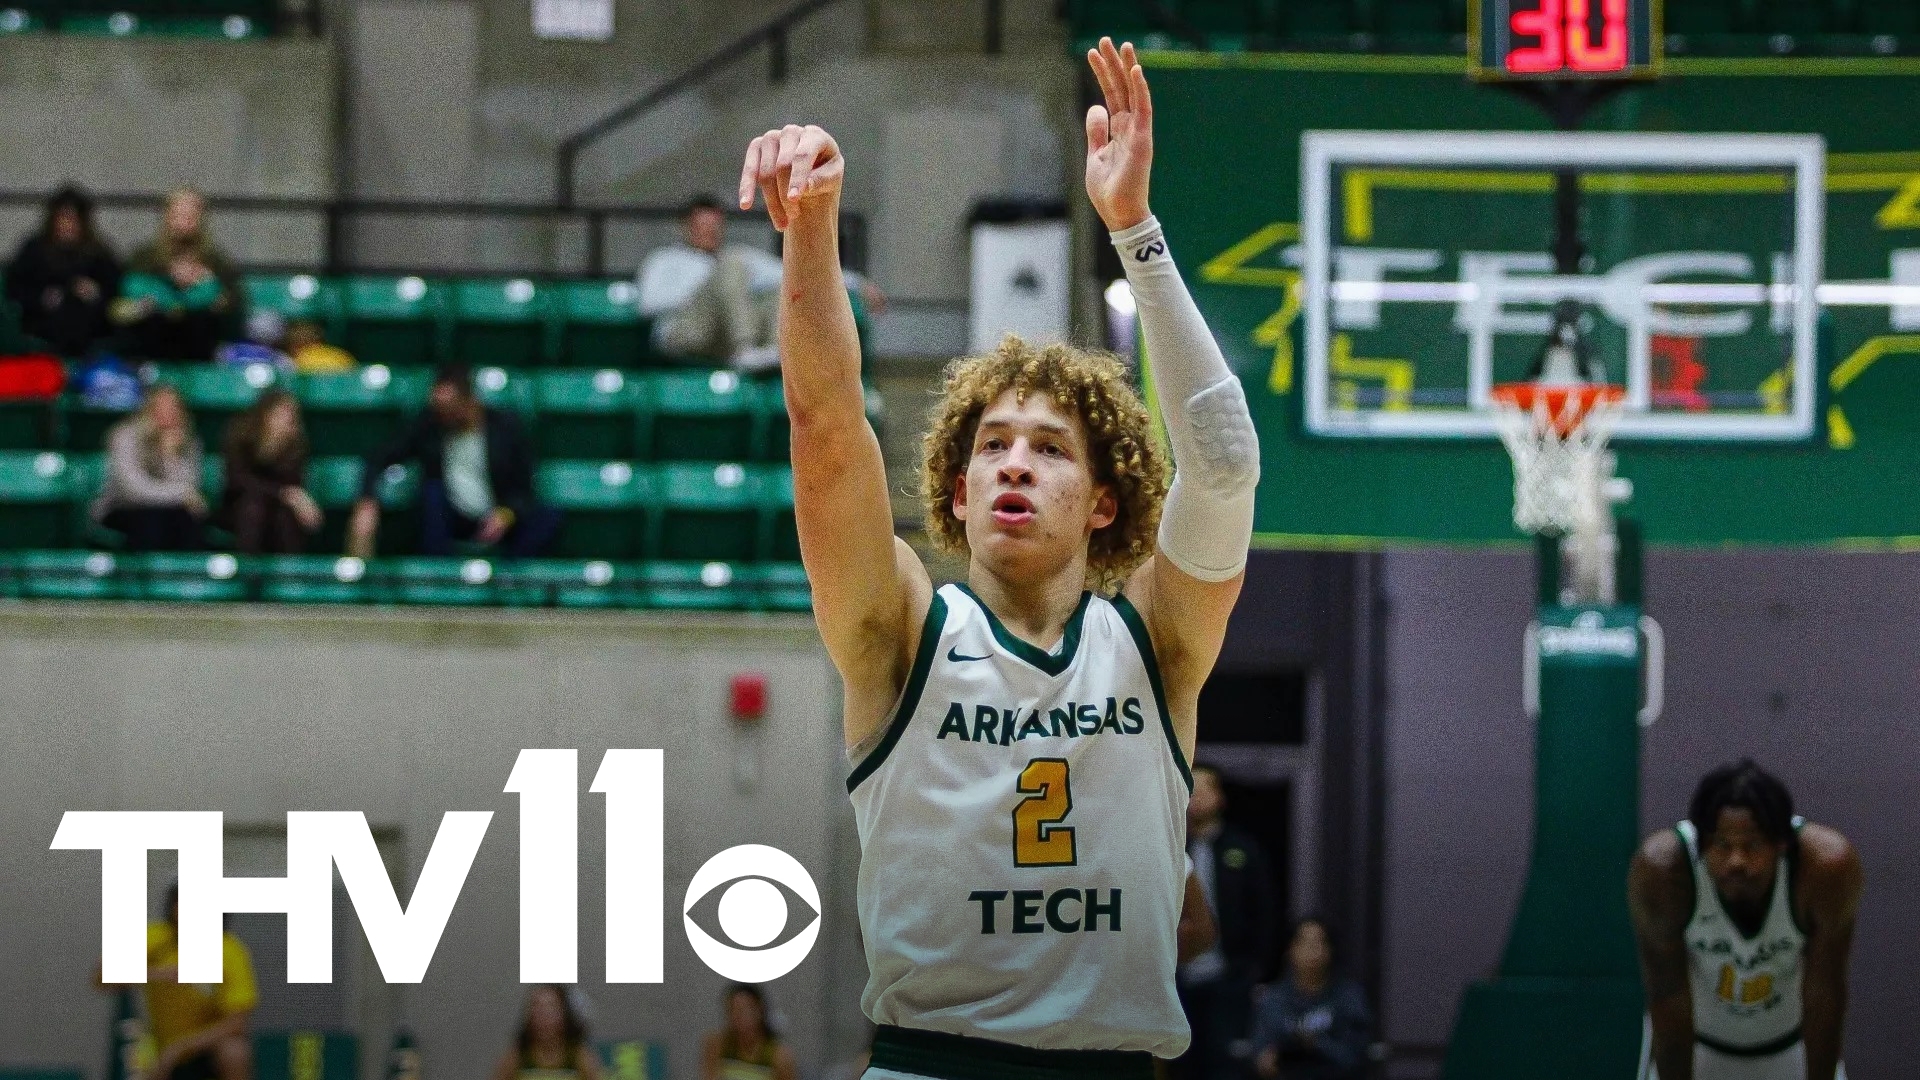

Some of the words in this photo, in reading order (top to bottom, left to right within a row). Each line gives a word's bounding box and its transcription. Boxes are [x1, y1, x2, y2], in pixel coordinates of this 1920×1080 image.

[1505, 0, 1627, 72] 30
[937, 697, 1145, 746] ARKANSAS
[1012, 757, 1077, 868] 2
[967, 887, 1122, 935] TECH
